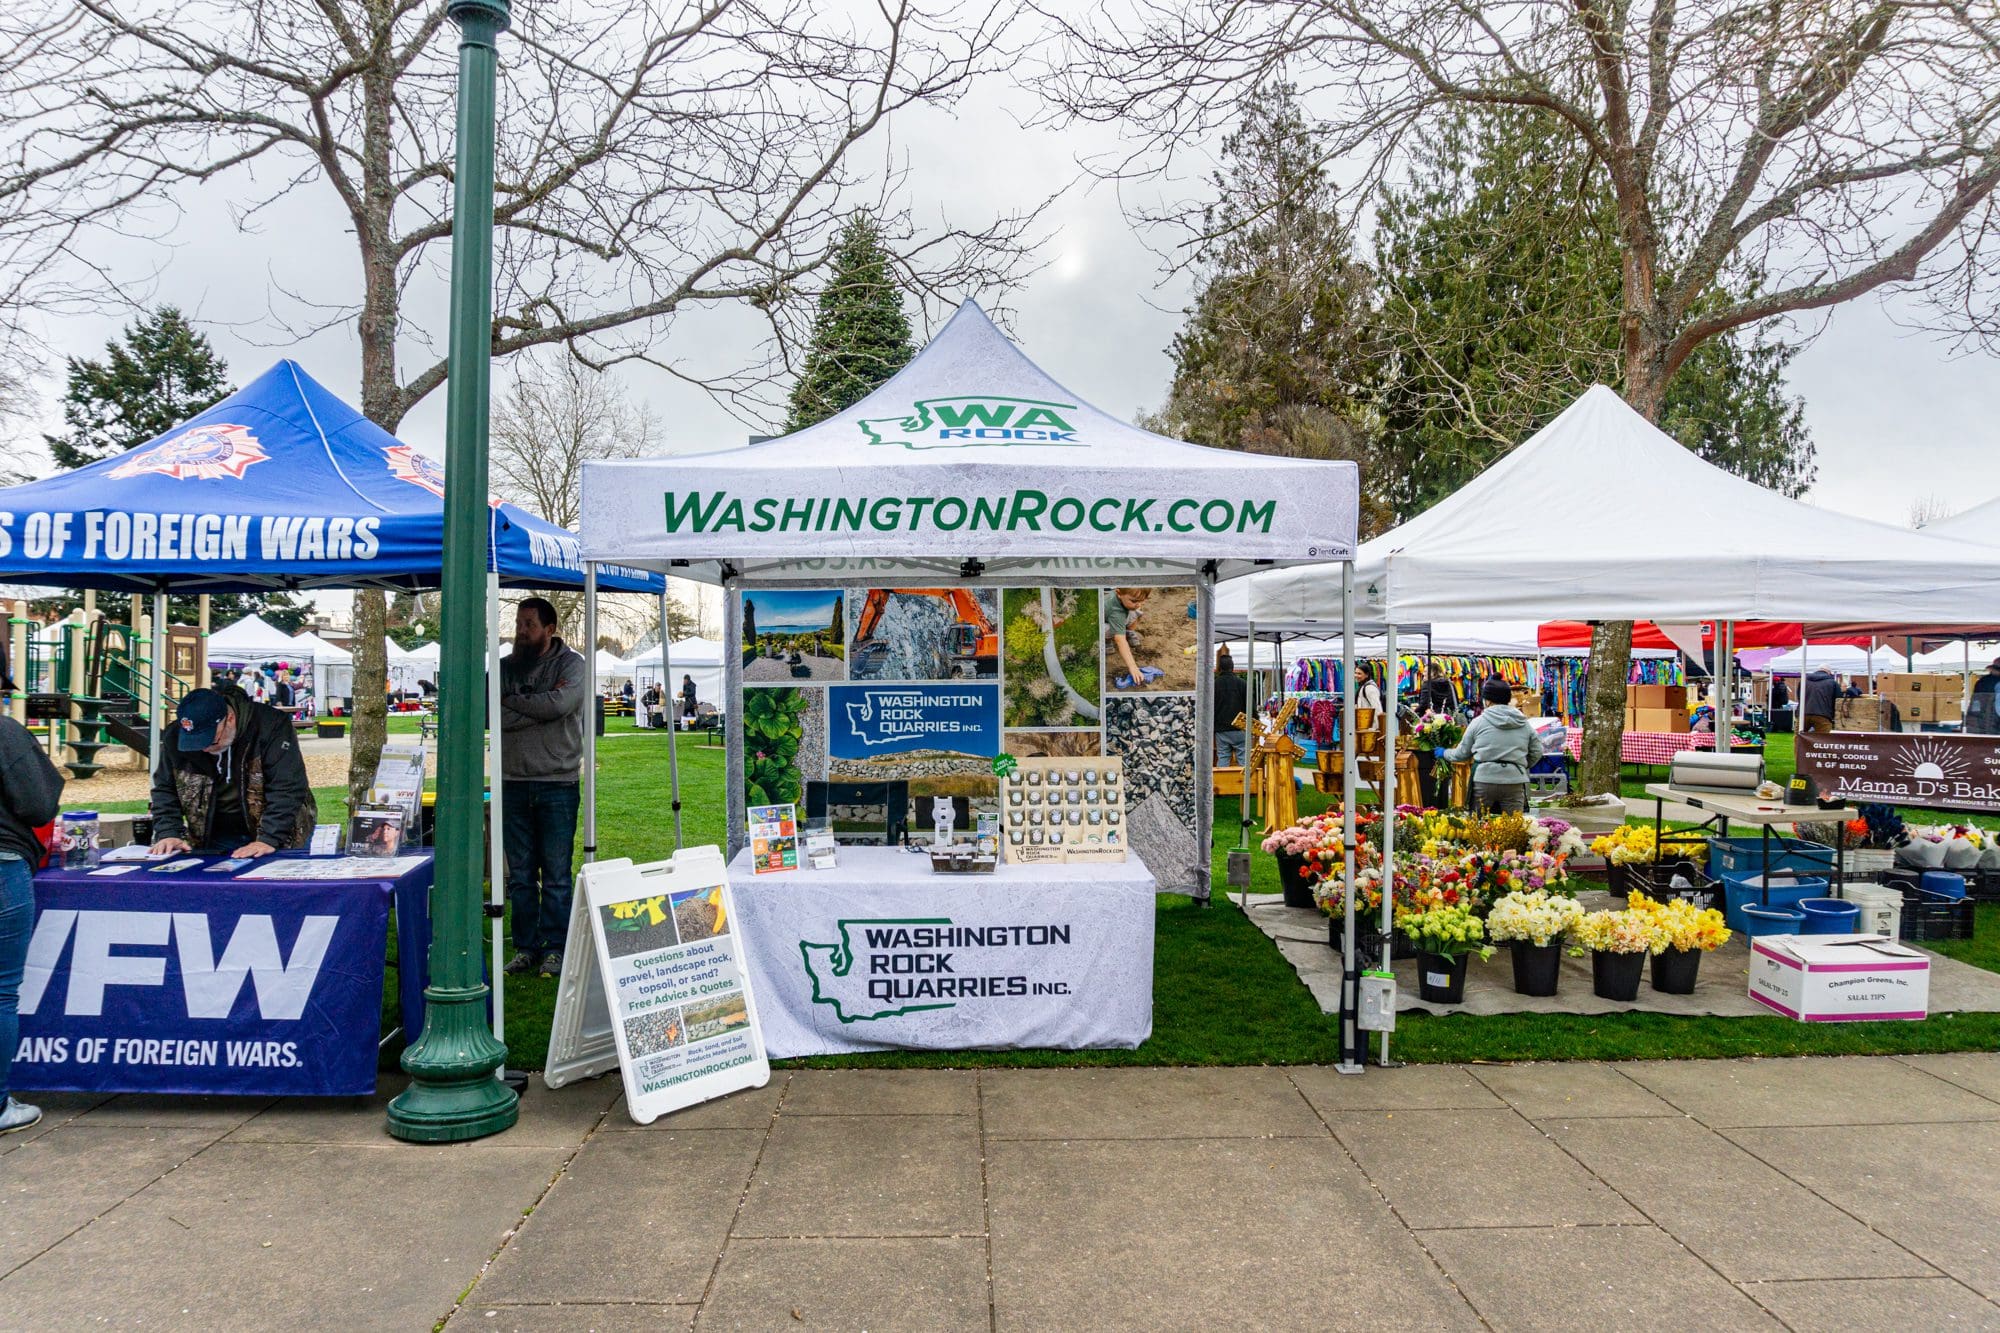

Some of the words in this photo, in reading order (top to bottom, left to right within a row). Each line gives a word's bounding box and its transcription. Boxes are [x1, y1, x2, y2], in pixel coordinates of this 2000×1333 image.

[934, 404, 1077, 432] WA
[940, 428, 1081, 442] ROCK
[23, 511, 74, 559] OF
[83, 511, 250, 560] FOREIGN
[260, 515, 381, 560] WARS
[1318, 548, 1348, 556] TentCraft
[878, 696, 982, 707] WASHINGTON
[880, 709, 924, 720] ROCK
[880, 721, 960, 735] QUARRIES
[1806, 752, 1840, 760] SWEETS,
[1813, 742, 1846, 750] GLUTEN
[1838, 776, 1910, 794] Mama
[1916, 780, 1948, 796] D's
[1942, 798, 1986, 806] FARMHOUSE
[865, 924, 1070, 948] WASHINGTON
[633, 950, 684, 969] Questions
[686, 944, 714, 956] about
[870, 953, 955, 974] ROCK
[619, 970, 654, 987] gravel,
[656, 959, 706, 976] landscape
[708, 953, 732, 966] rock,
[639, 978, 676, 994] topsoil,
[678, 976, 688, 985] or
[692, 968, 718, 982] sand?
[868, 976, 1027, 1003] QUARRIES
[1032, 982, 1072, 995] INC.
[1758, 978, 1772, 989] SALAL
[1828, 978, 1866, 988] Champion
[1896, 978, 1908, 986] Inc.
[628, 998, 651, 1011] Free
[654, 988, 688, 1005] Advice
[690, 986, 698, 996] &
[700, 978, 734, 992] Quotes
[11, 1037, 68, 1064] ANS
[76, 1037, 110, 1064] OF
[113, 1038, 218, 1066] FOREIGN
[226, 1041, 304, 1067] WARS.
[686, 1053, 711, 1064] Products
[712, 1048, 728, 1058] Made
[728, 1043, 747, 1053] Locally
[688, 1048, 703, 1056] Rock,
[704, 1043, 720, 1051] Sand,
[721, 1039, 732, 1047] and
[732, 1036, 742, 1044] Soil
